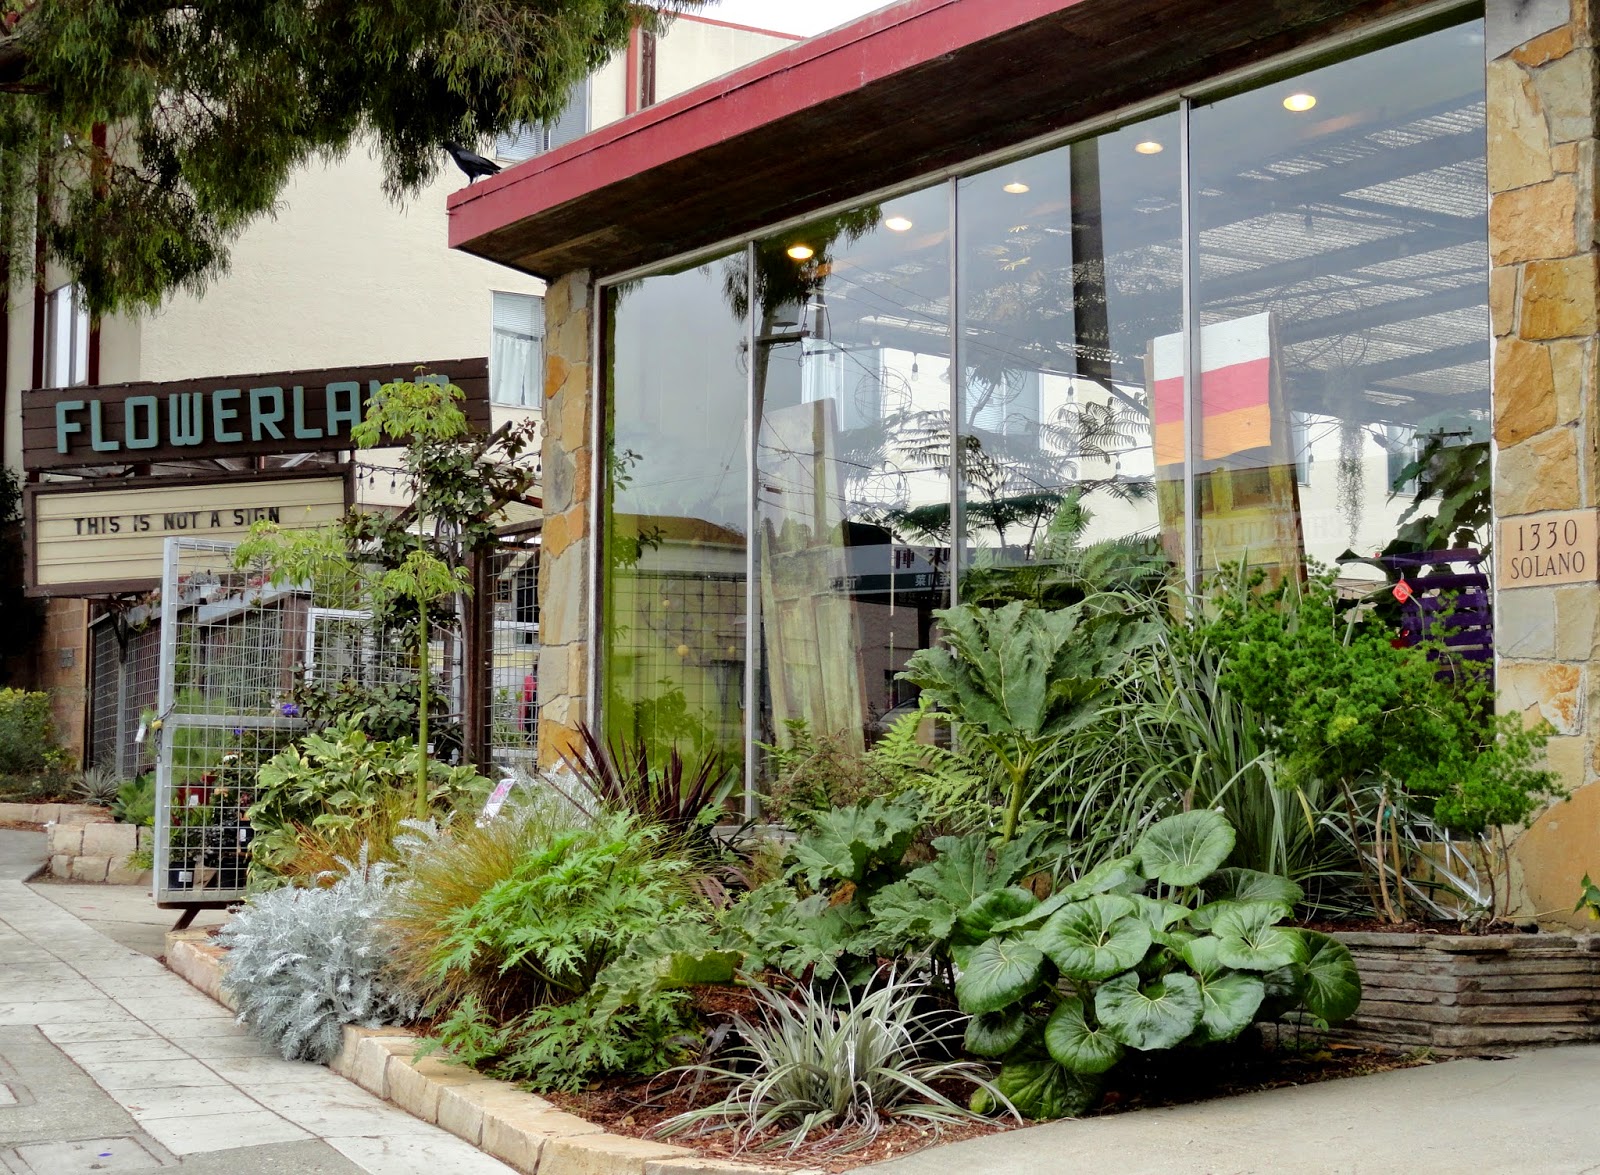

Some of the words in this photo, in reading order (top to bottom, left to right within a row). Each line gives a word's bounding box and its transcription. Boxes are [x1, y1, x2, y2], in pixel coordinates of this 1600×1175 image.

[55, 374, 452, 454] FLOWERLA
[74, 516, 120, 535] THIS
[134, 514, 150, 532] IS
[163, 511, 200, 530] NOT
[210, 510, 221, 528] A
[233, 506, 280, 526] SIGN
[1518, 519, 1578, 551] 1330
[1510, 550, 1585, 580] SOLANO
